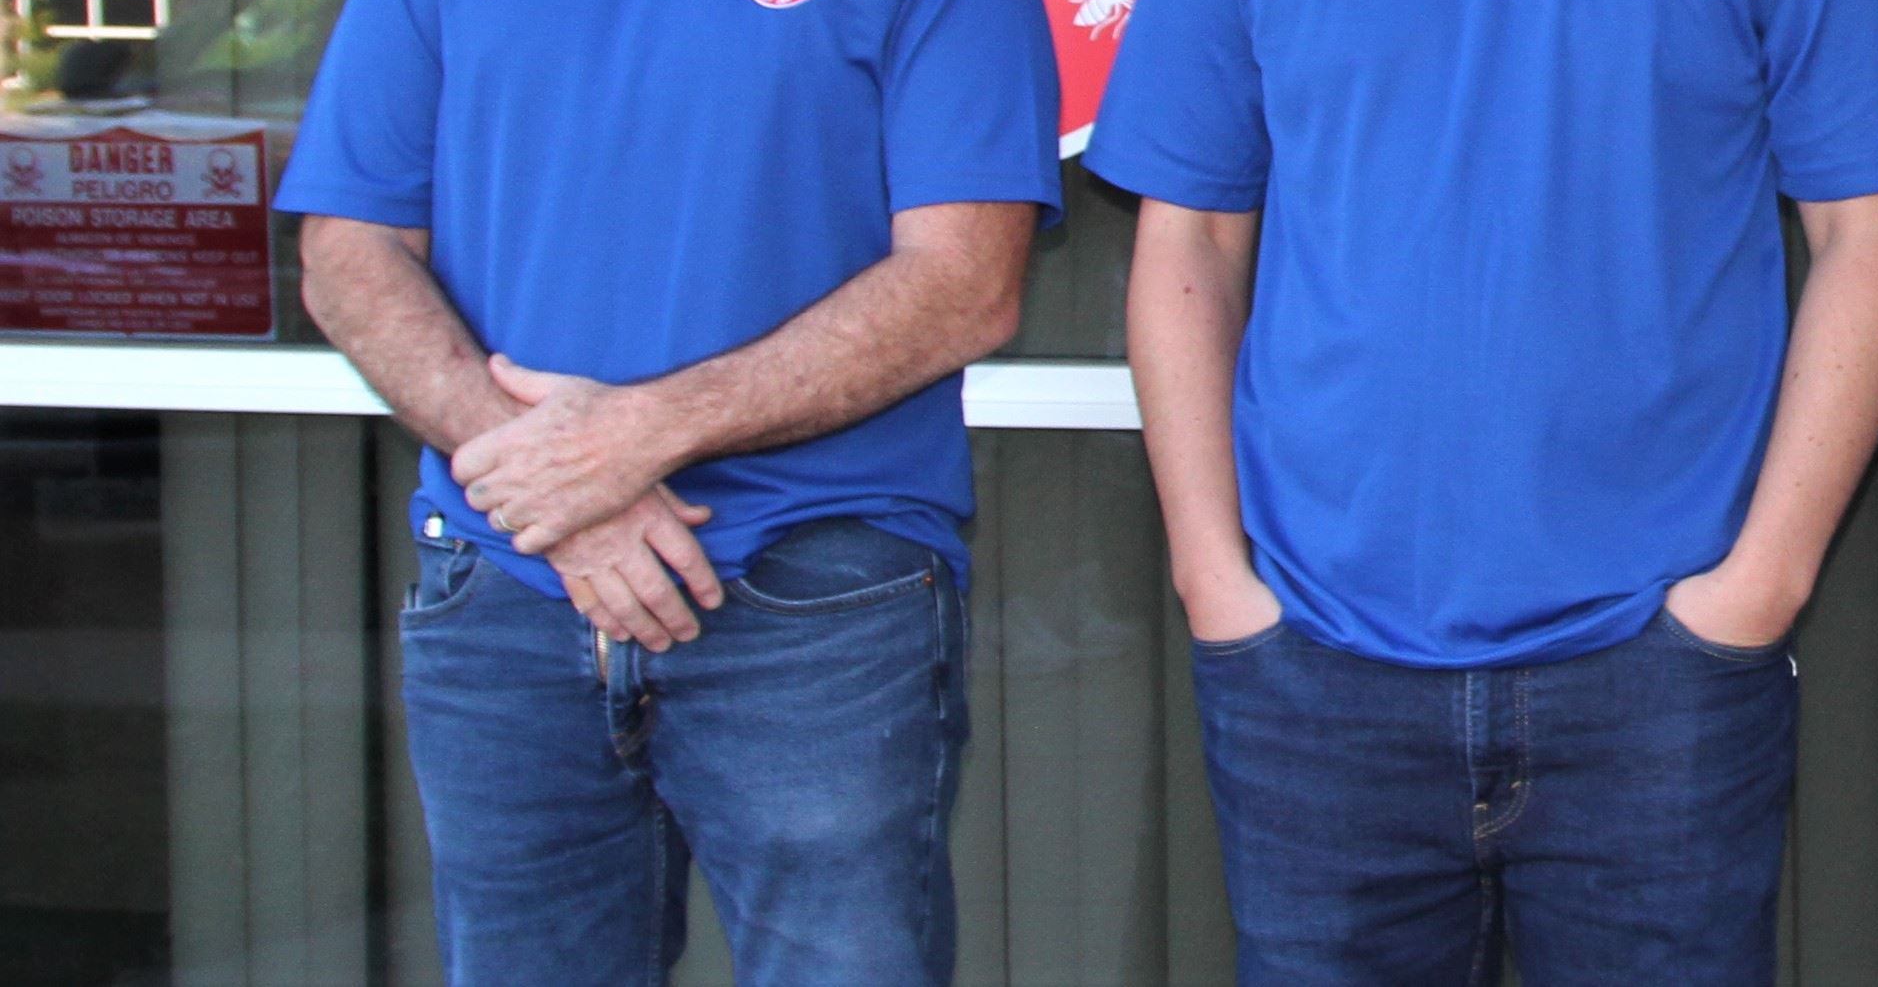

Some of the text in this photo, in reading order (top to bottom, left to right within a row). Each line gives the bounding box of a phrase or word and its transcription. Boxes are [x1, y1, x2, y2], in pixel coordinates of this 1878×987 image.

[70, 144, 173, 173] DANGER
[72, 180, 174, 200] PELIGRO
[11, 208, 235, 228] POISON STORAGE AREA
